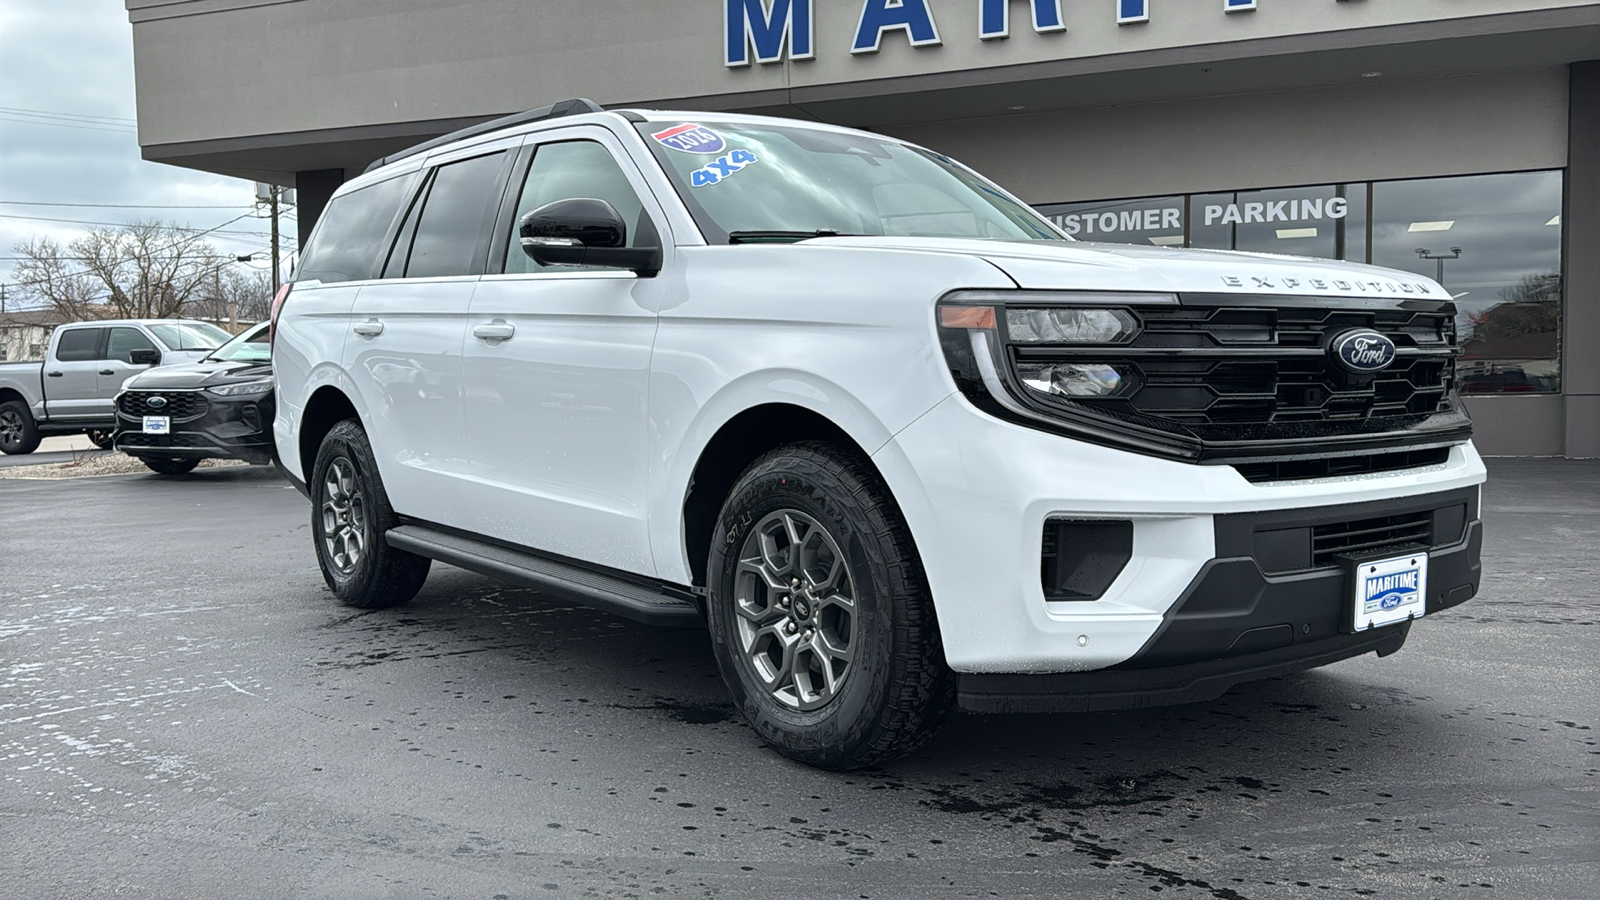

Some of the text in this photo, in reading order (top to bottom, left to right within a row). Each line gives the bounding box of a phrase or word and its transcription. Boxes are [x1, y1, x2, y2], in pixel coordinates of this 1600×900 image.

[667, 129, 717, 150] 2026
[1204, 196, 1348, 226] PARKING
[1220, 275, 1431, 295] EXPEDITION
[1350, 337, 1387, 364] Ford
[1366, 570, 1418, 601] MARITIME
[1382, 595, 1400, 609] Ford
